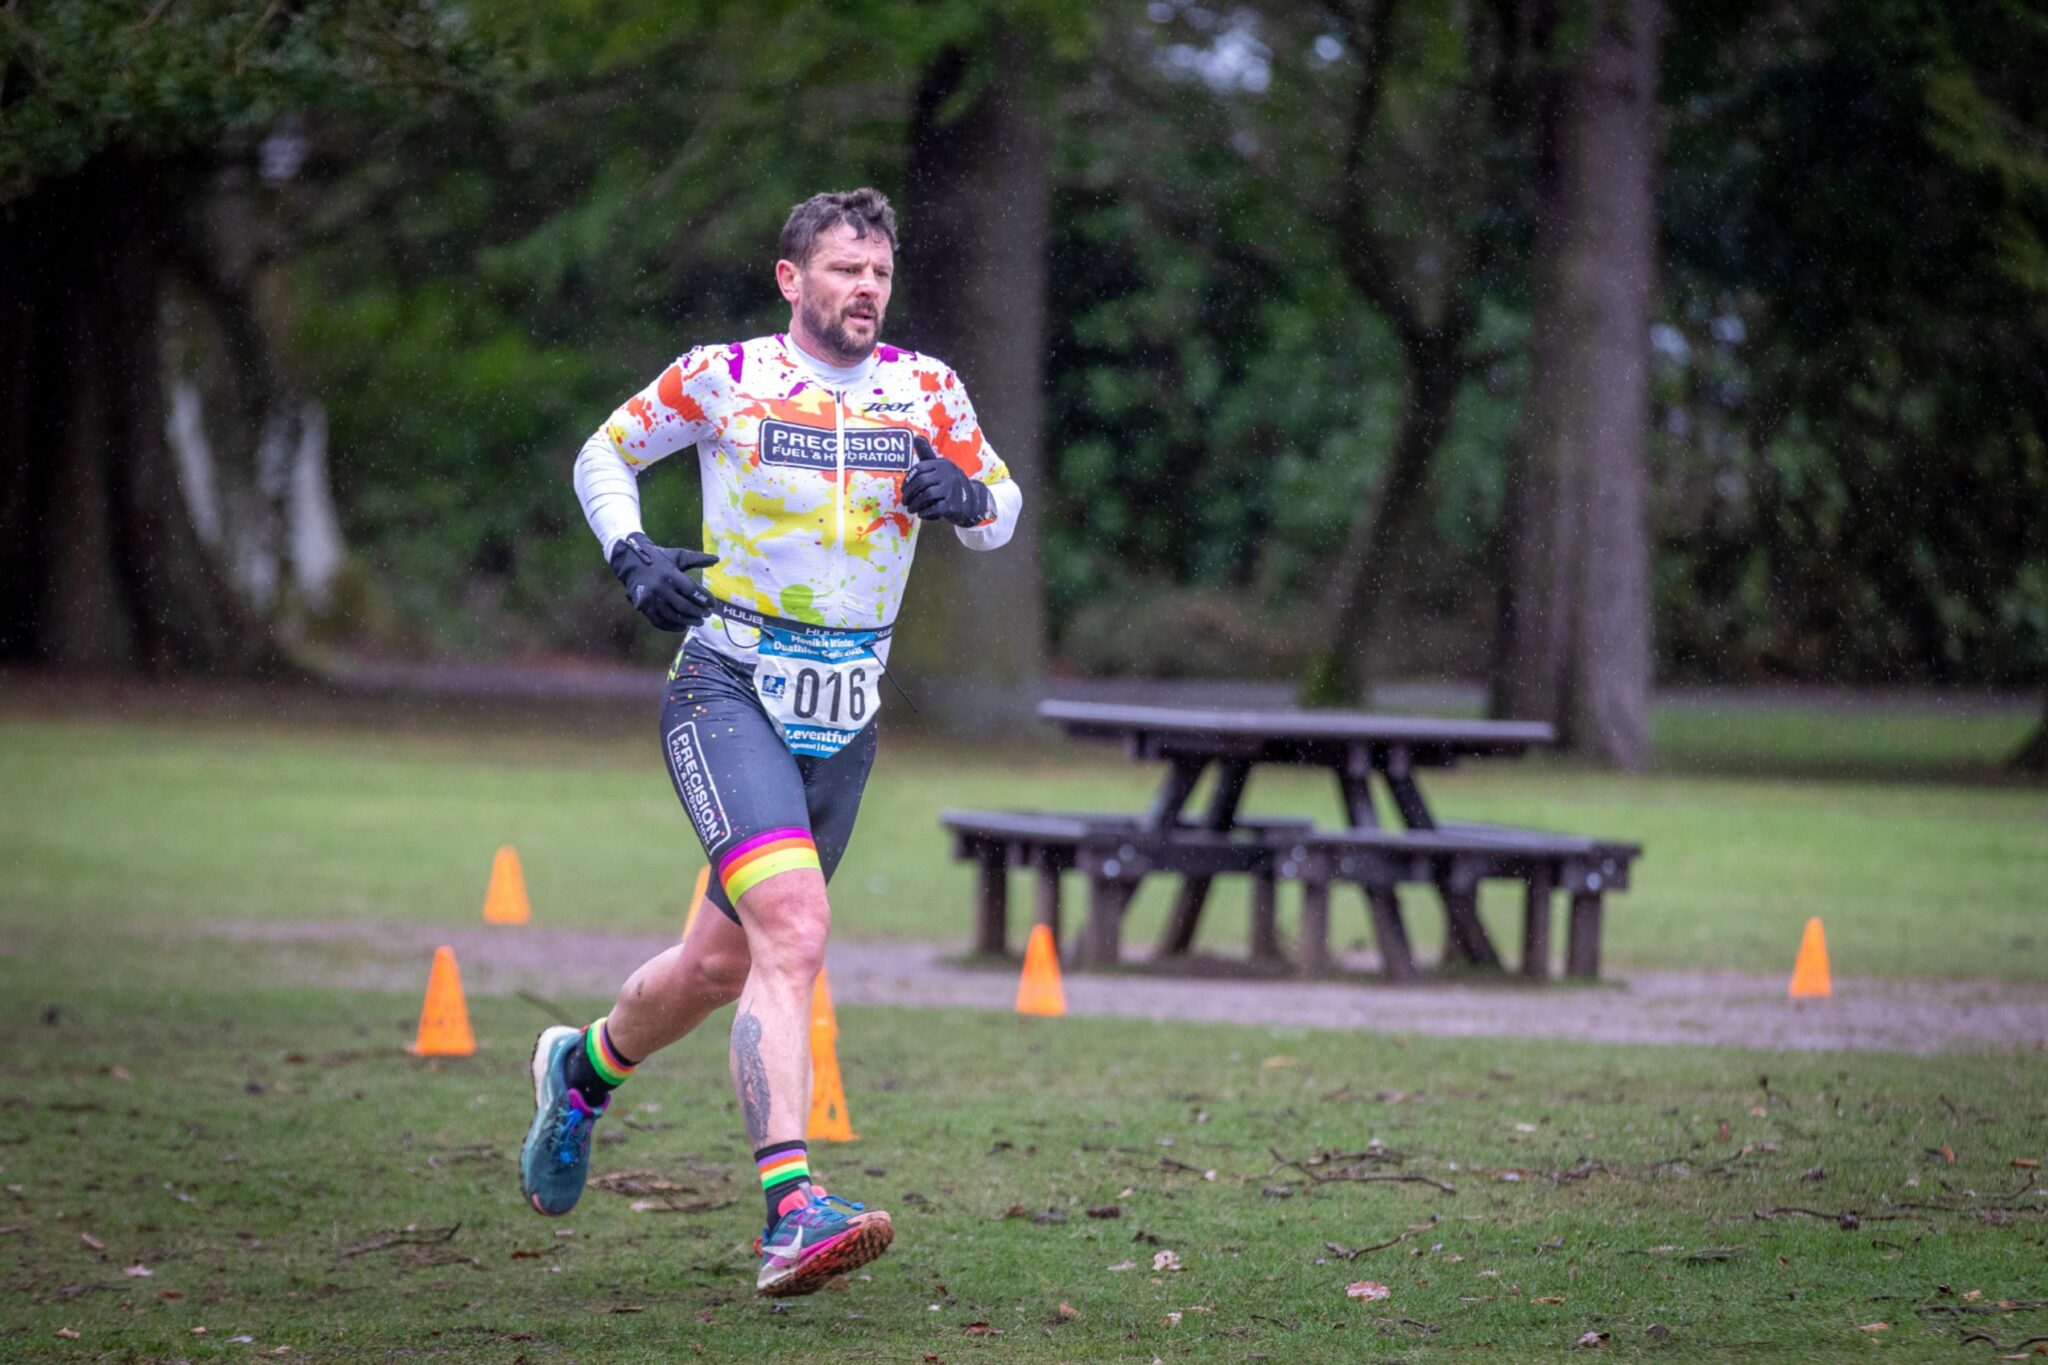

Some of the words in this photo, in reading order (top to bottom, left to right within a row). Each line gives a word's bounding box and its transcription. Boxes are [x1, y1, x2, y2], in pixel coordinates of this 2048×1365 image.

[772, 429, 905, 452] PRECISION
[772, 446, 809, 459] FUEL
[812, 450, 822, 461] &
[722, 606, 764, 624] HUUB
[773, 640, 819, 656] Duathlon
[793, 667, 866, 723] 016
[672, 739, 683, 771] FUEL
[678, 733, 720, 840] PRECISION
